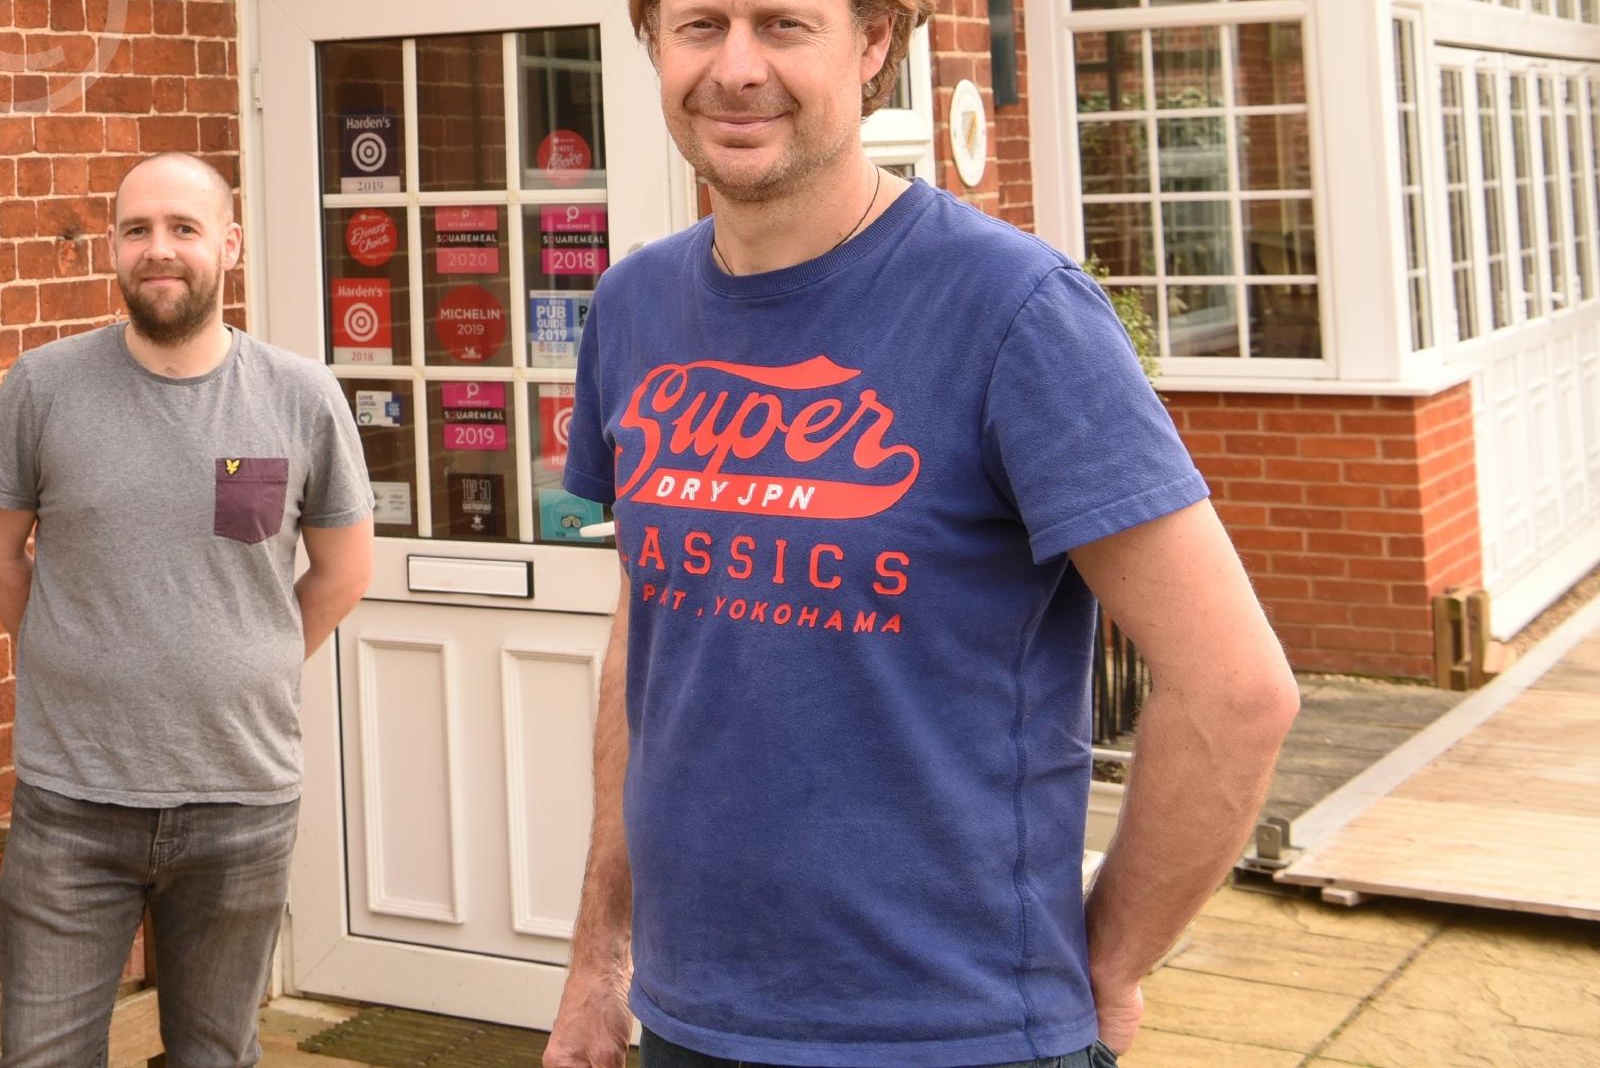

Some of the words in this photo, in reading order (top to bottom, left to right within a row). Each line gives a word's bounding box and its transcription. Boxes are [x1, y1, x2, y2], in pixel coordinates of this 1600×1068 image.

[346, 116, 391, 130] Harden's
[357, 180, 384, 192] 2019
[436, 233, 497, 244] SQUAREMEAL
[542, 234, 604, 245] SQUAREMEAL
[448, 252, 488, 267] 2020
[553, 251, 595, 269] 2018
[337, 284, 384, 298] Harden's
[440, 308, 500, 320] MICHELIN
[536, 305, 566, 319] PUB
[456, 323, 485, 336] 2019
[536, 318, 567, 329] GUIDE
[537, 329, 568, 341] 2019
[351, 351, 374, 362] 2018
[444, 410, 504, 421] SQUAREMEAL
[455, 427, 495, 445] 2019
[615, 356, 921, 507] Super
[462, 478, 477, 500] TOP
[479, 479, 491, 500] 50
[614, 520, 910, 596] ASSICS
[714, 594, 902, 633] YOKOHAMA
